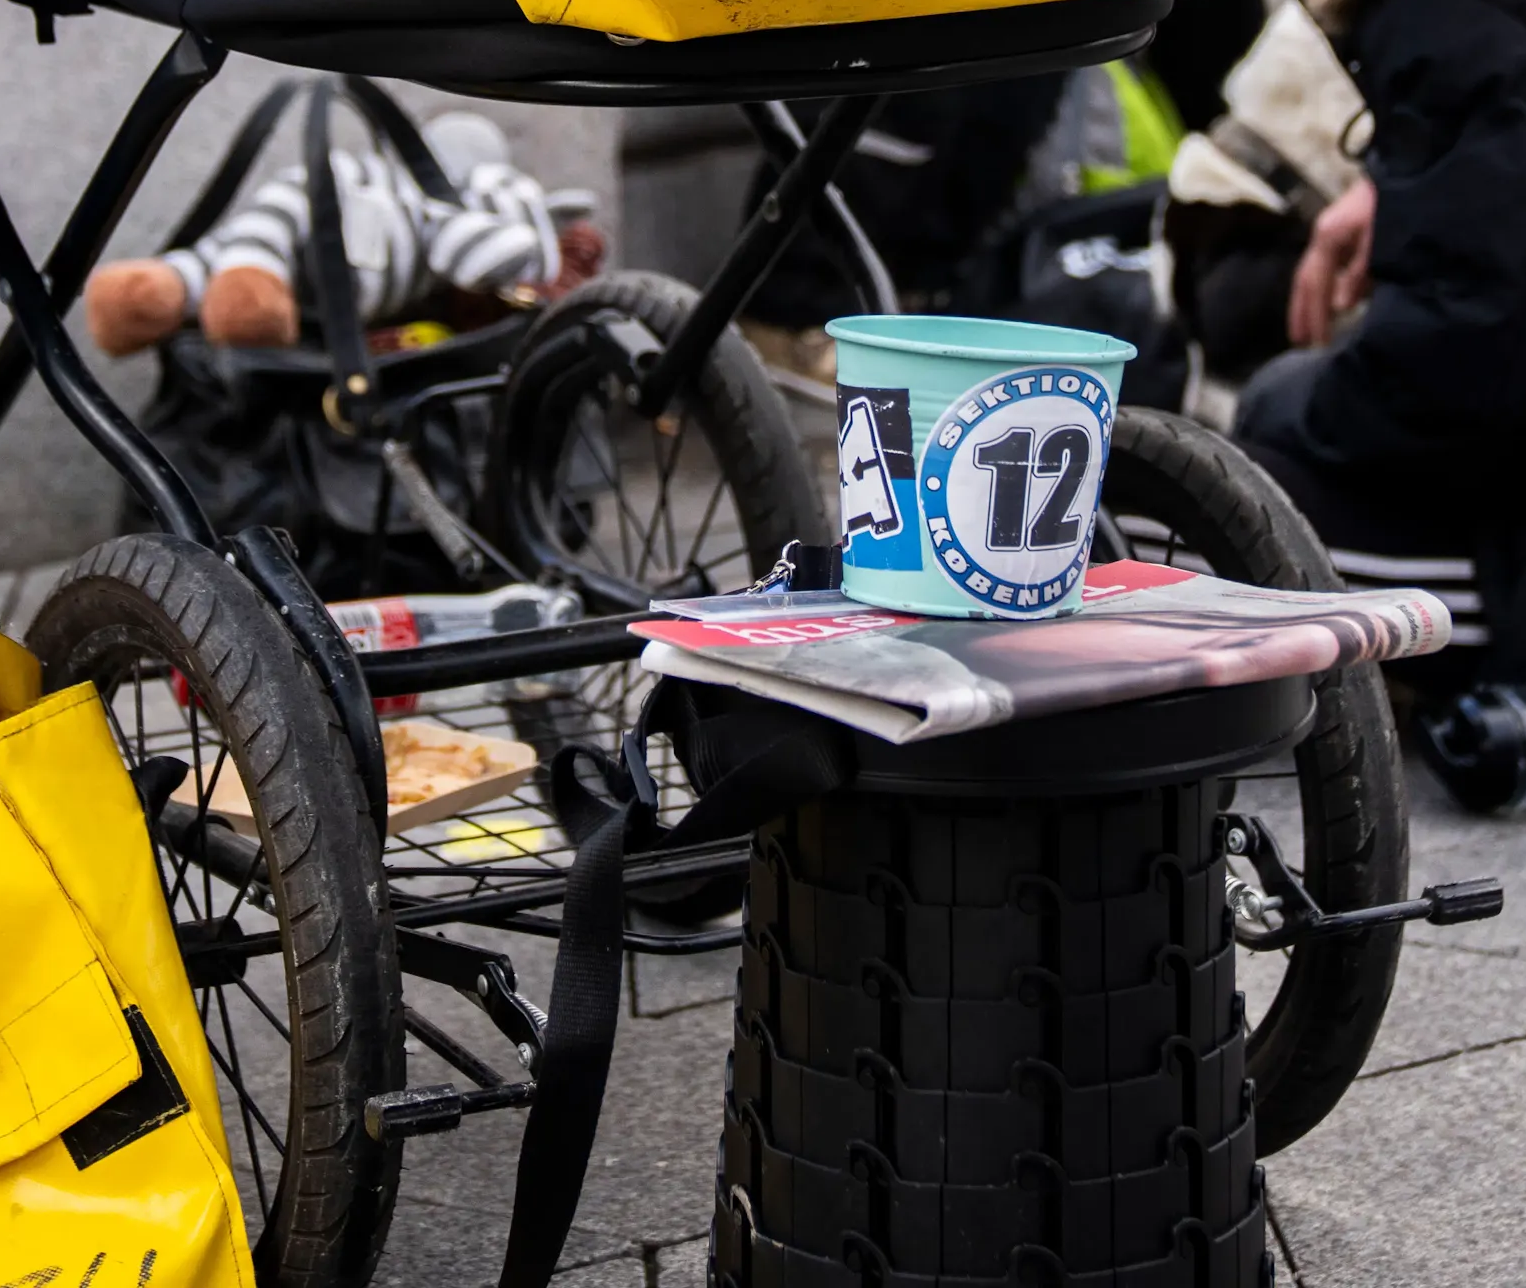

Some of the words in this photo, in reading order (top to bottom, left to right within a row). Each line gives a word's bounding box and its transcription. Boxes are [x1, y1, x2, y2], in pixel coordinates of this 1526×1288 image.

[937, 373, 1102, 450] SEKTION
[974, 424, 1093, 552] 12
[702, 614, 896, 644] hus
